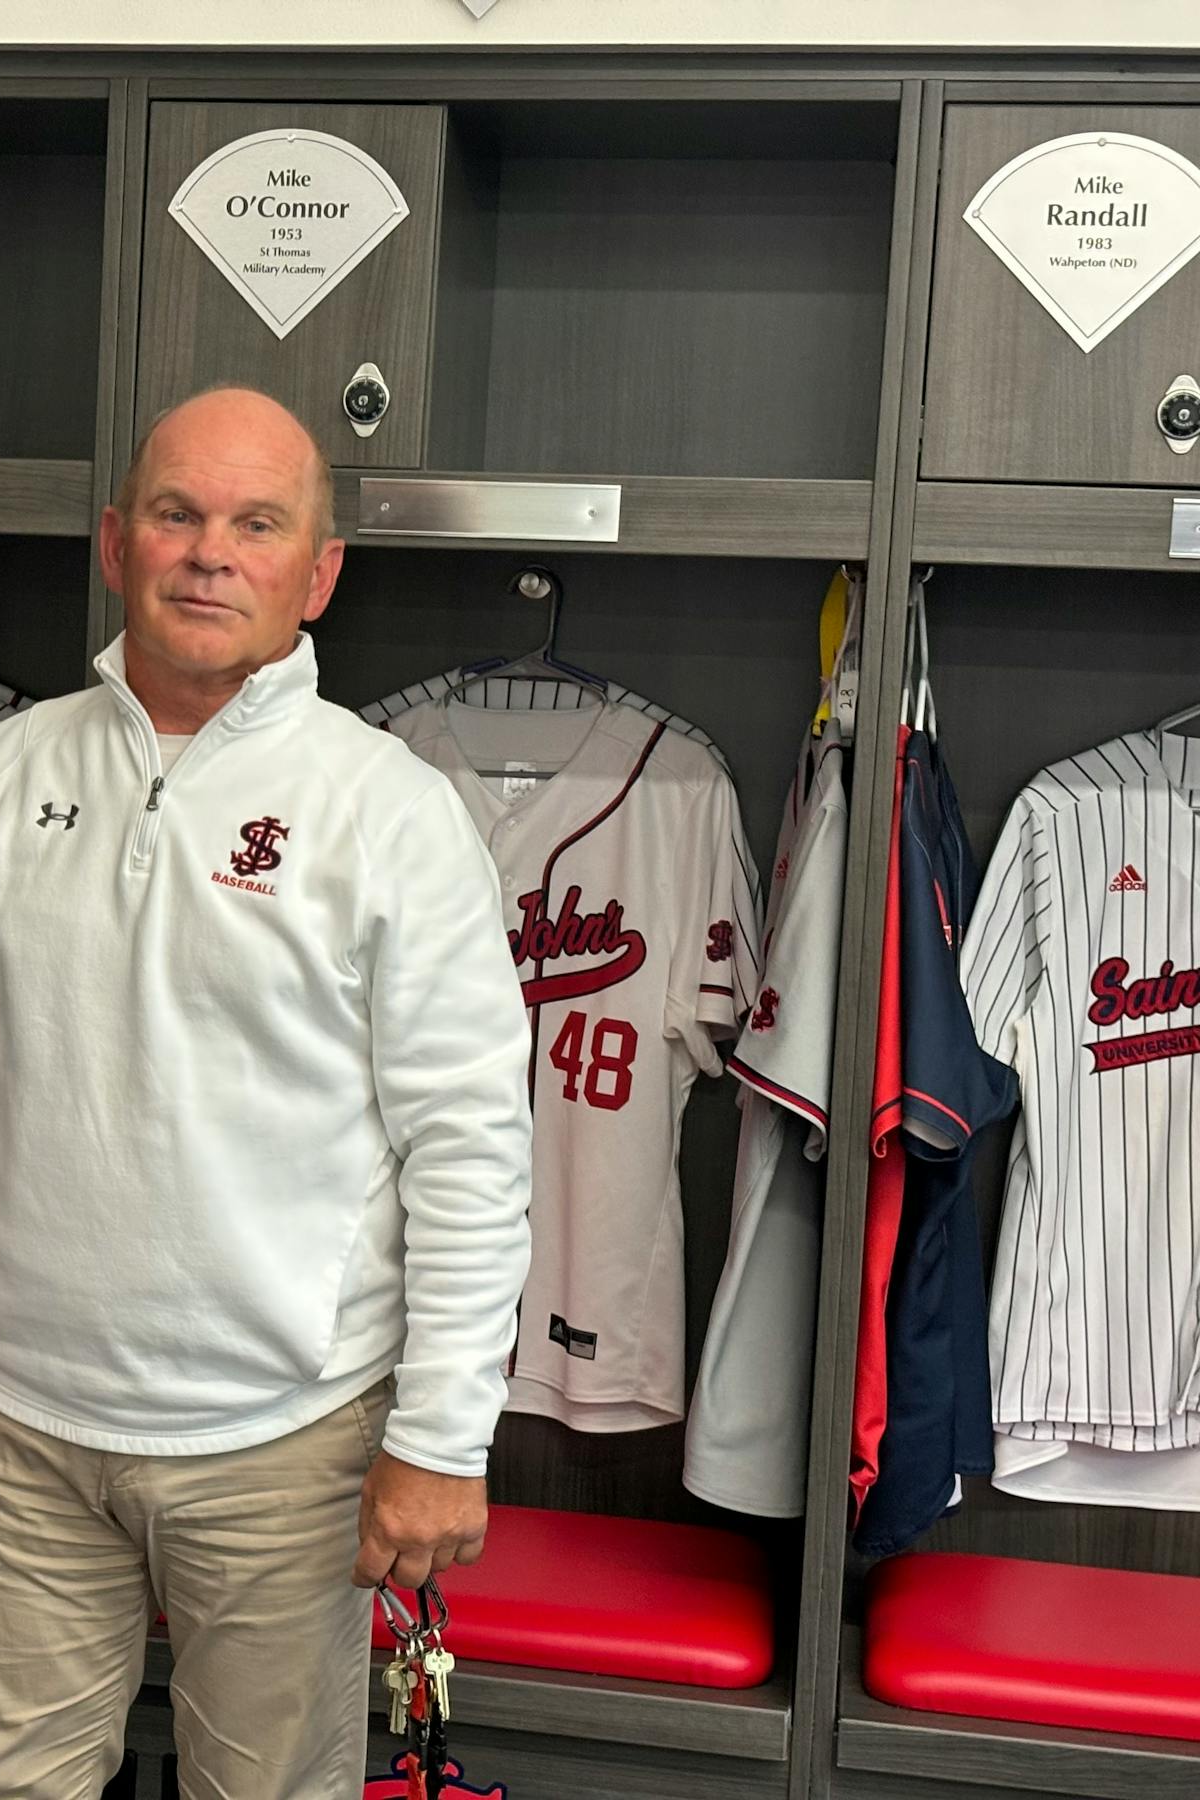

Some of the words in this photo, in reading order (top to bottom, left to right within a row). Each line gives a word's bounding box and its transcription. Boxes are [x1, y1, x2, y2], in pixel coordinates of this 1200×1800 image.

[267, 169, 311, 187] Mike
[1074, 176, 1124, 195] Mike
[226, 195, 350, 219] O'Connor
[1047, 203, 1148, 227] Randall
[270, 228, 302, 240] 1953
[260, 247, 270, 257] St
[273, 247, 311, 257] Thomas
[1077, 237, 1113, 250] 1983
[243, 263, 279, 276] Military
[282, 265, 326, 277] Academy
[1050, 257, 1106, 269] Wahpeton
[1109, 257, 1137, 268] (ND)
[210, 871, 277, 897] BASEBALL
[1108, 880, 1147, 892] adidas
[1088, 957, 1200, 1026] Sain
[549, 1010, 639, 1111] 48
